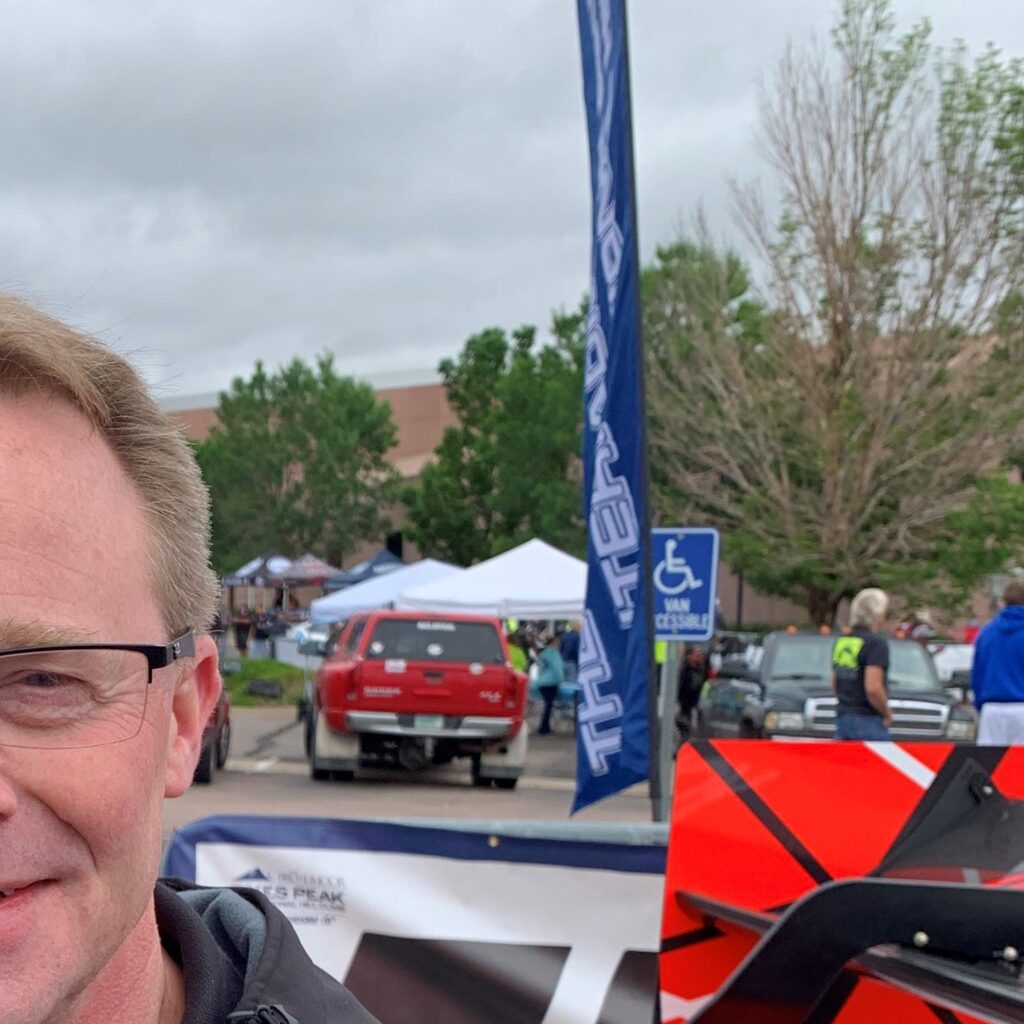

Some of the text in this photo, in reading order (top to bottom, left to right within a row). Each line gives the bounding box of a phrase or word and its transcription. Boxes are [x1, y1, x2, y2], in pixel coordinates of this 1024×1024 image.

[664, 598, 691, 613] VAN
[655, 613, 710, 629] CESSIBLE
[293, 887, 345, 905] PEAK
